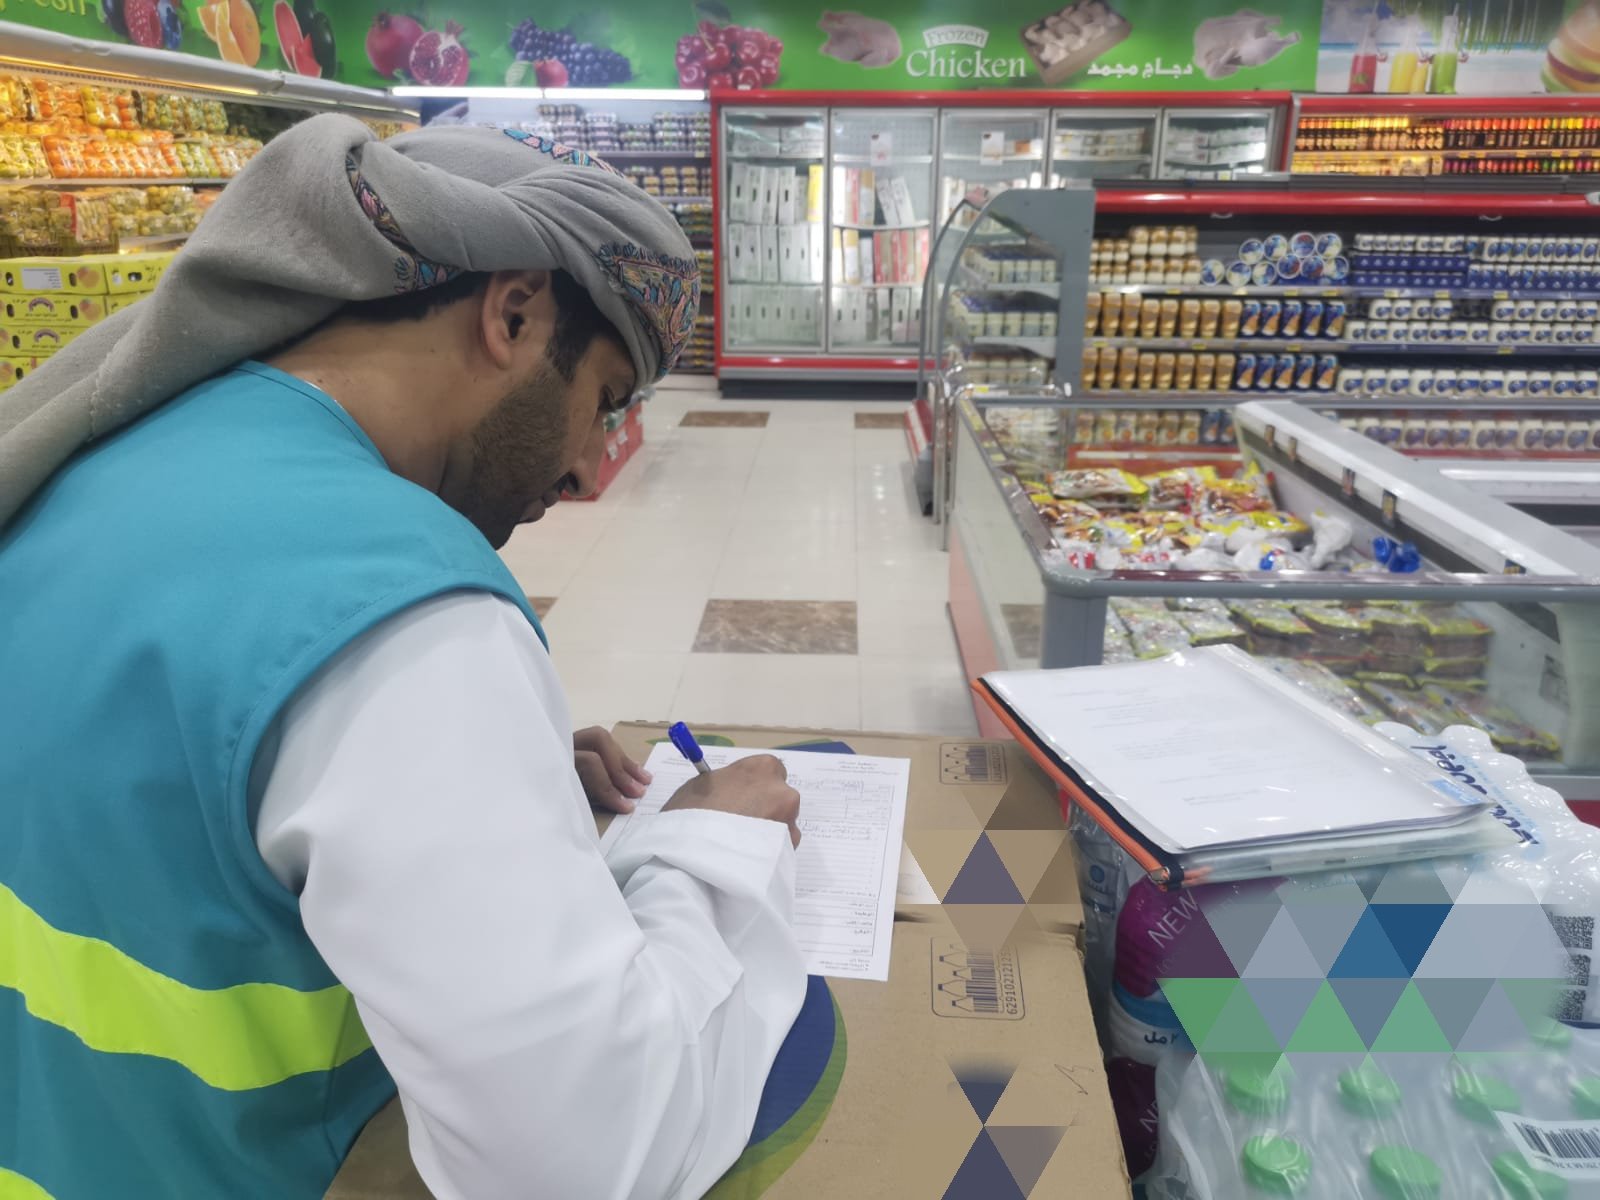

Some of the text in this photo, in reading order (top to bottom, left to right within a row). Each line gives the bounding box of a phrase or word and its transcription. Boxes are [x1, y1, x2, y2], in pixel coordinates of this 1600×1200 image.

[926, 29, 985, 46] Frozen
[905, 48, 1027, 79] Chicken
[1087, 57, 1193, 79] دجاج مجمد
[1147, 888, 1200, 949] NEW
